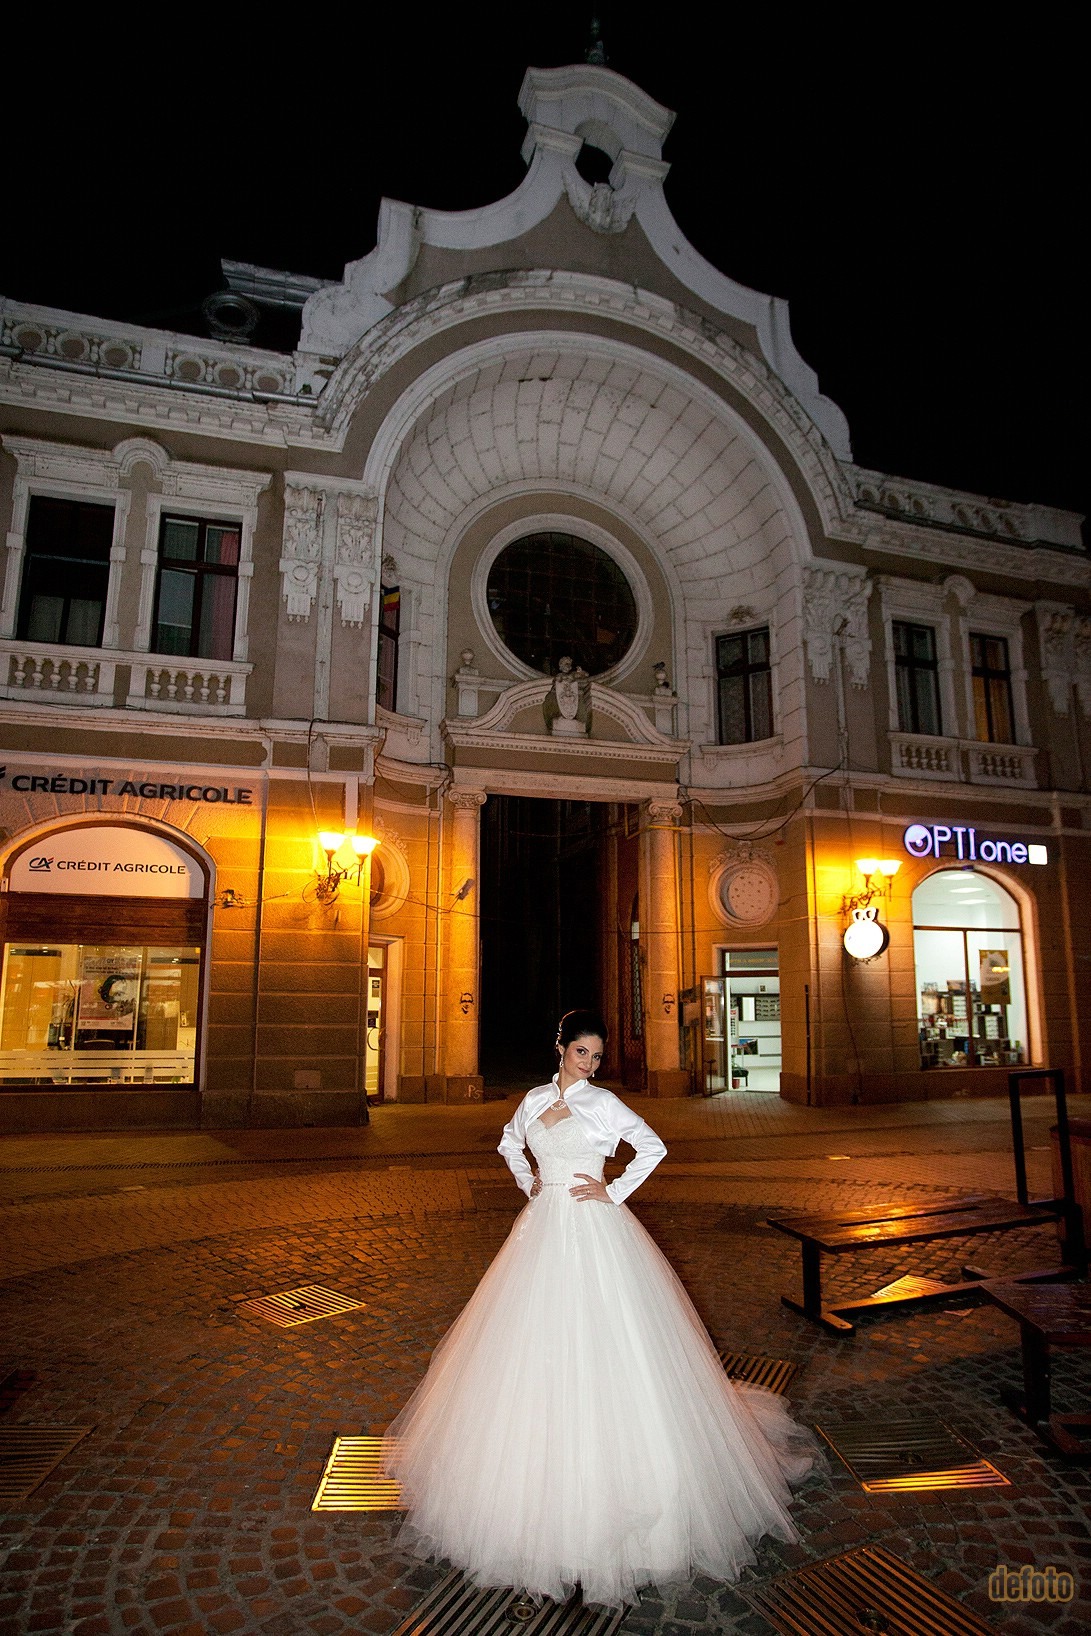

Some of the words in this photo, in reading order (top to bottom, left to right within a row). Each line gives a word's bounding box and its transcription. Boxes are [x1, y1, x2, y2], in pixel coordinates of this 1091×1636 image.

[11, 774, 113, 795] CRÉDIT
[118, 781, 253, 804] AGRICOLE
[979, 840, 1028, 863] one
[57, 860, 110, 871] CRÉDIT
[113, 863, 186, 874] AGRICOLE
